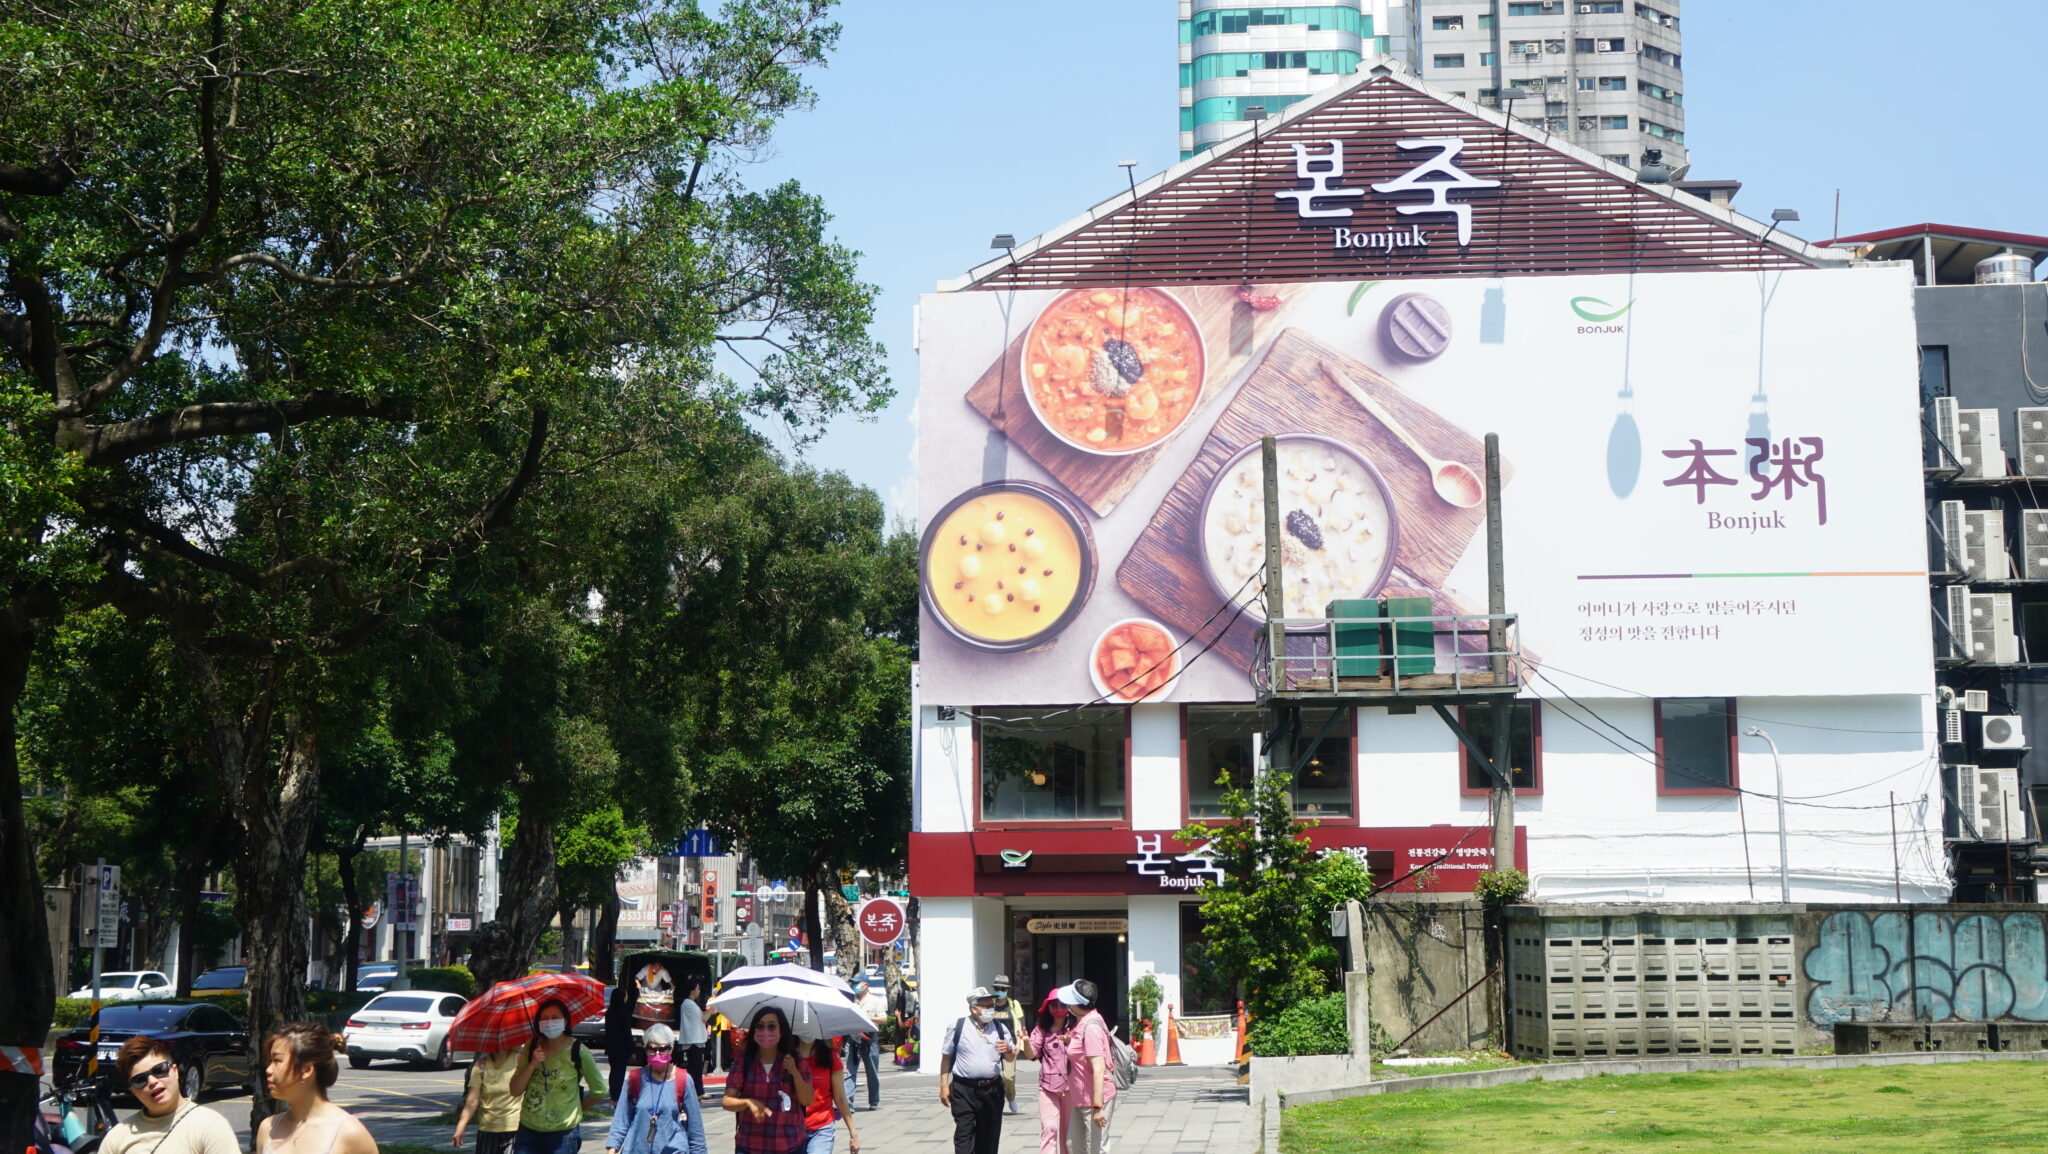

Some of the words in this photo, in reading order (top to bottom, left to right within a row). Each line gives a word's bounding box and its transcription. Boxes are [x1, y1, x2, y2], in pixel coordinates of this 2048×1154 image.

[1274, 138, 1502, 246] 본죽
[1334, 224, 1428, 254] Bonjuk
[1577, 325, 1624, 334] BONJUK
[1661, 436, 1827, 526] 本粥
[1707, 510, 1786, 534] Bonjuk
[1577, 601, 1637, 617] 어머니가
[1640, 600, 1701, 617] 사랑으로
[1706, 599, 1797, 616] 만들어주시던
[1578, 625, 1623, 642] 정성의
[1627, 625, 1657, 641] 맛을
[1661, 624, 1720, 640] 전합니다
[1159, 875, 1206, 890] Bonjuk
[864, 912, 898, 931] 본죽
